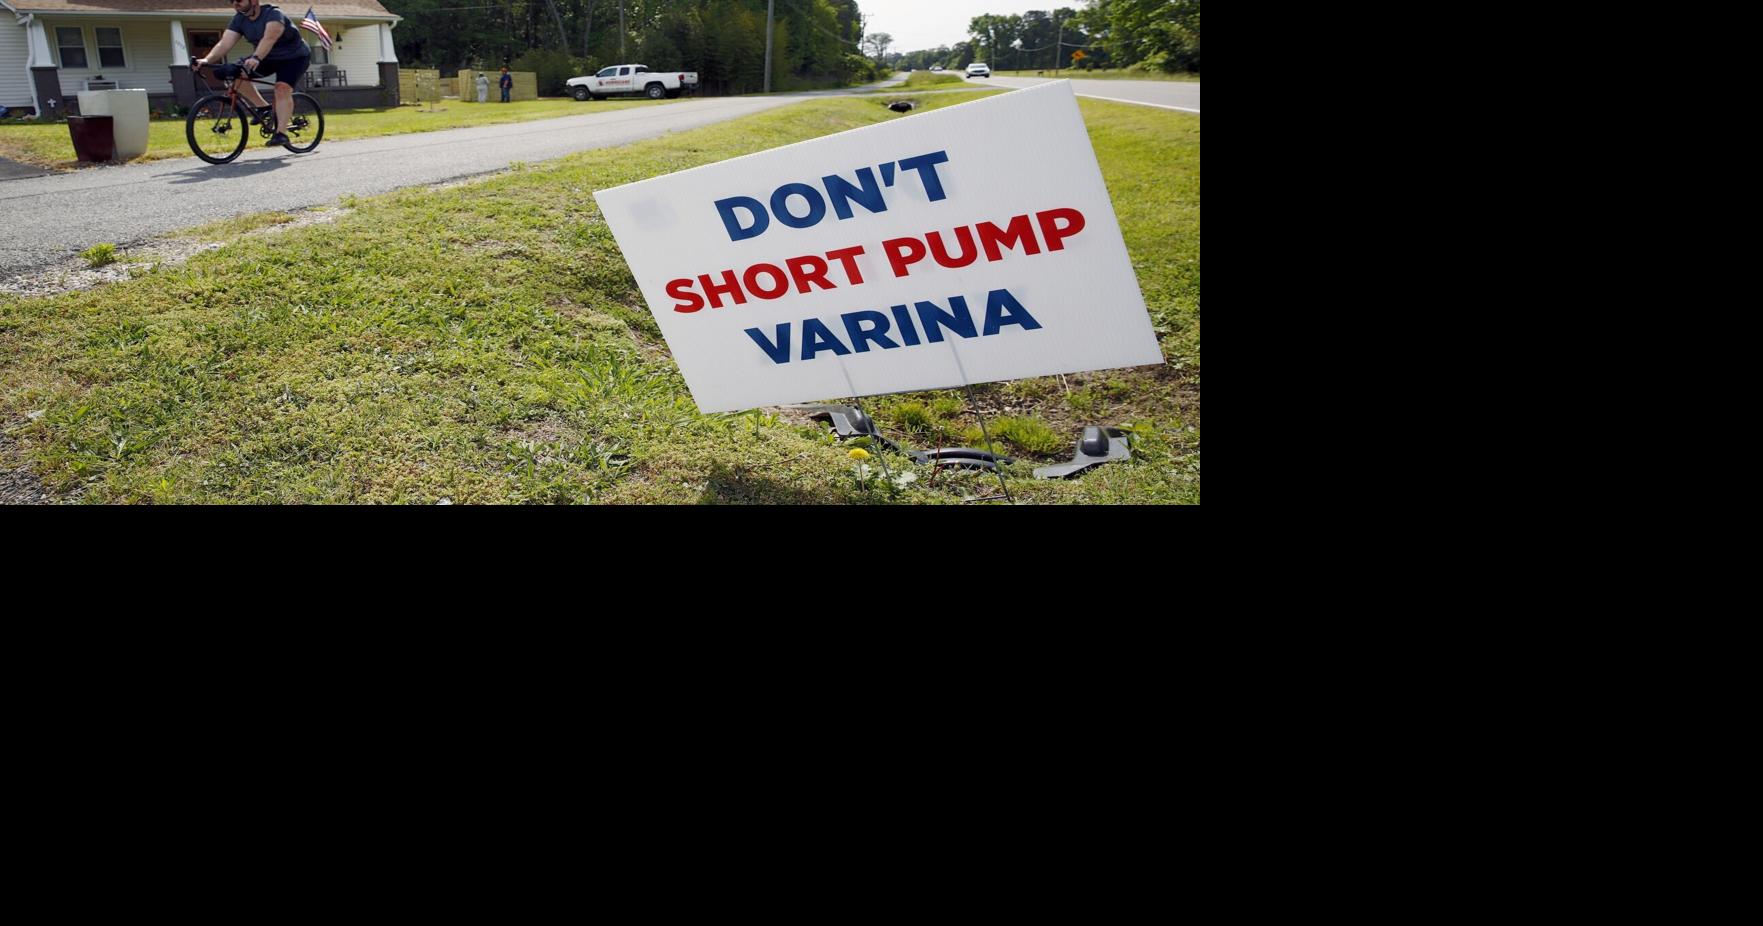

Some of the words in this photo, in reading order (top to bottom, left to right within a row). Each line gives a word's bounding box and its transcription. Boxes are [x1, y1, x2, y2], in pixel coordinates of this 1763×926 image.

[714, 150, 949, 242] DON'T
[665, 245, 866, 314] SHORT
[882, 207, 1086, 278] PUMP
[744, 288, 1042, 365] VARINA
